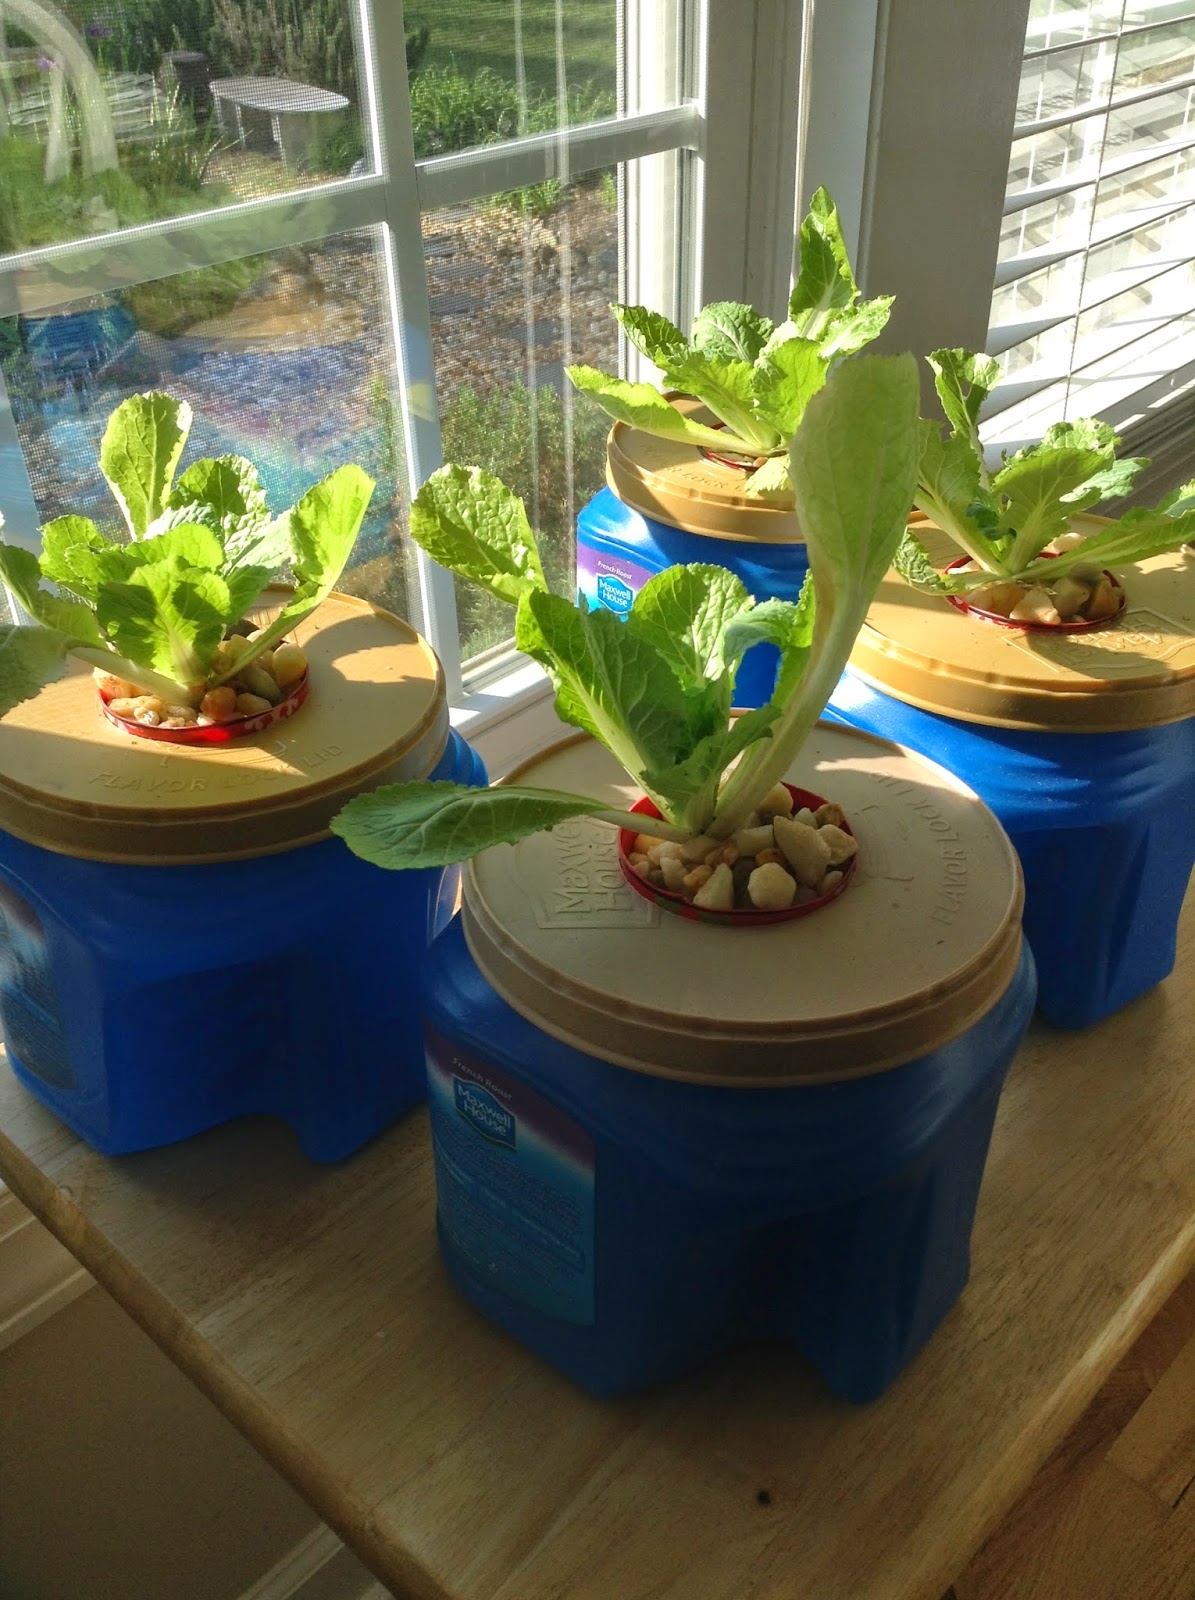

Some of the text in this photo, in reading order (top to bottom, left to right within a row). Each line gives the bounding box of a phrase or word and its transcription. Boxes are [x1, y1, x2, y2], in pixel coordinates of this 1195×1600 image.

[598, 578, 631, 601] Maxwell
[615, 568, 633, 580] Roast
[602, 589, 628, 608] House
[88, 771, 206, 793] FLAVOR
[301, 744, 344, 768] LID
[905, 798, 960, 842] LOCK
[552, 819, 593, 915] Maxwel
[927, 850, 969, 925] FLAVOR
[453, 1057, 513, 1101] French Roast
[457, 1084, 511, 1129] Maxwell
[463, 1099, 507, 1136] House
